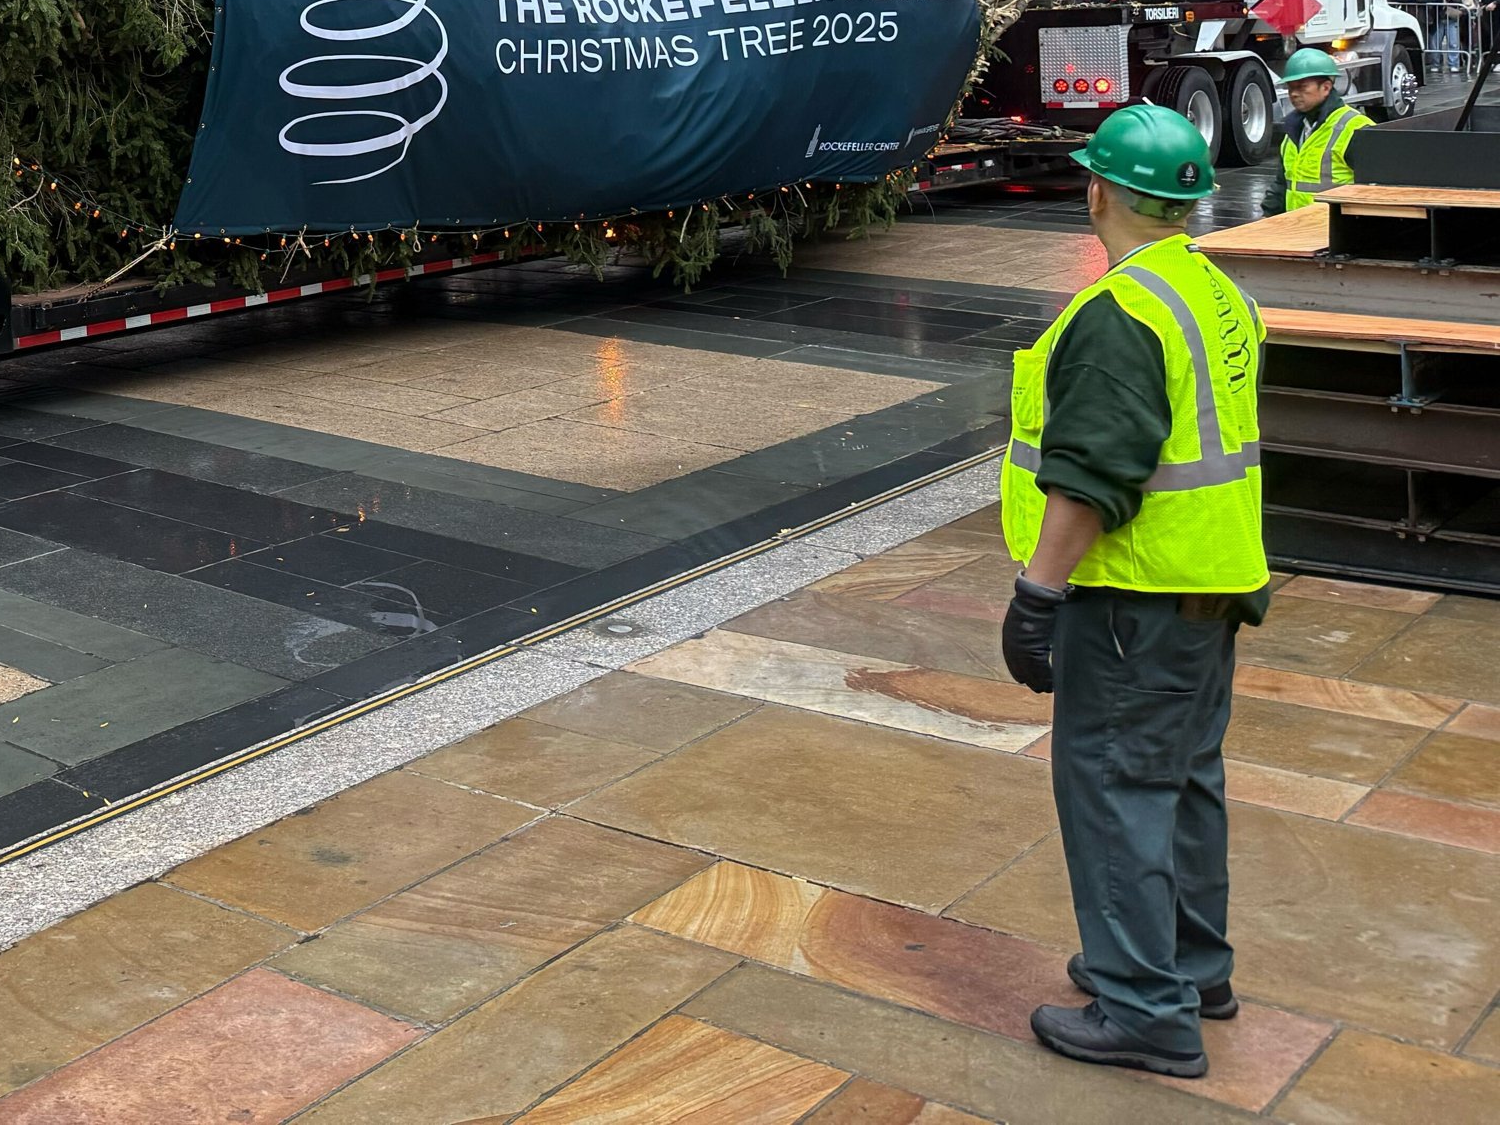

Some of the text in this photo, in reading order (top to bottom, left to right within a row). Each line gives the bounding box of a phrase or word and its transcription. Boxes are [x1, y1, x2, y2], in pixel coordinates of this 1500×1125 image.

[1144, 6, 1180, 21] TORSILIERI
[495, 11, 899, 74] CHRISTMAS TREE 2025
[818, 141, 900, 152] ROCKEFELLER CENTER
